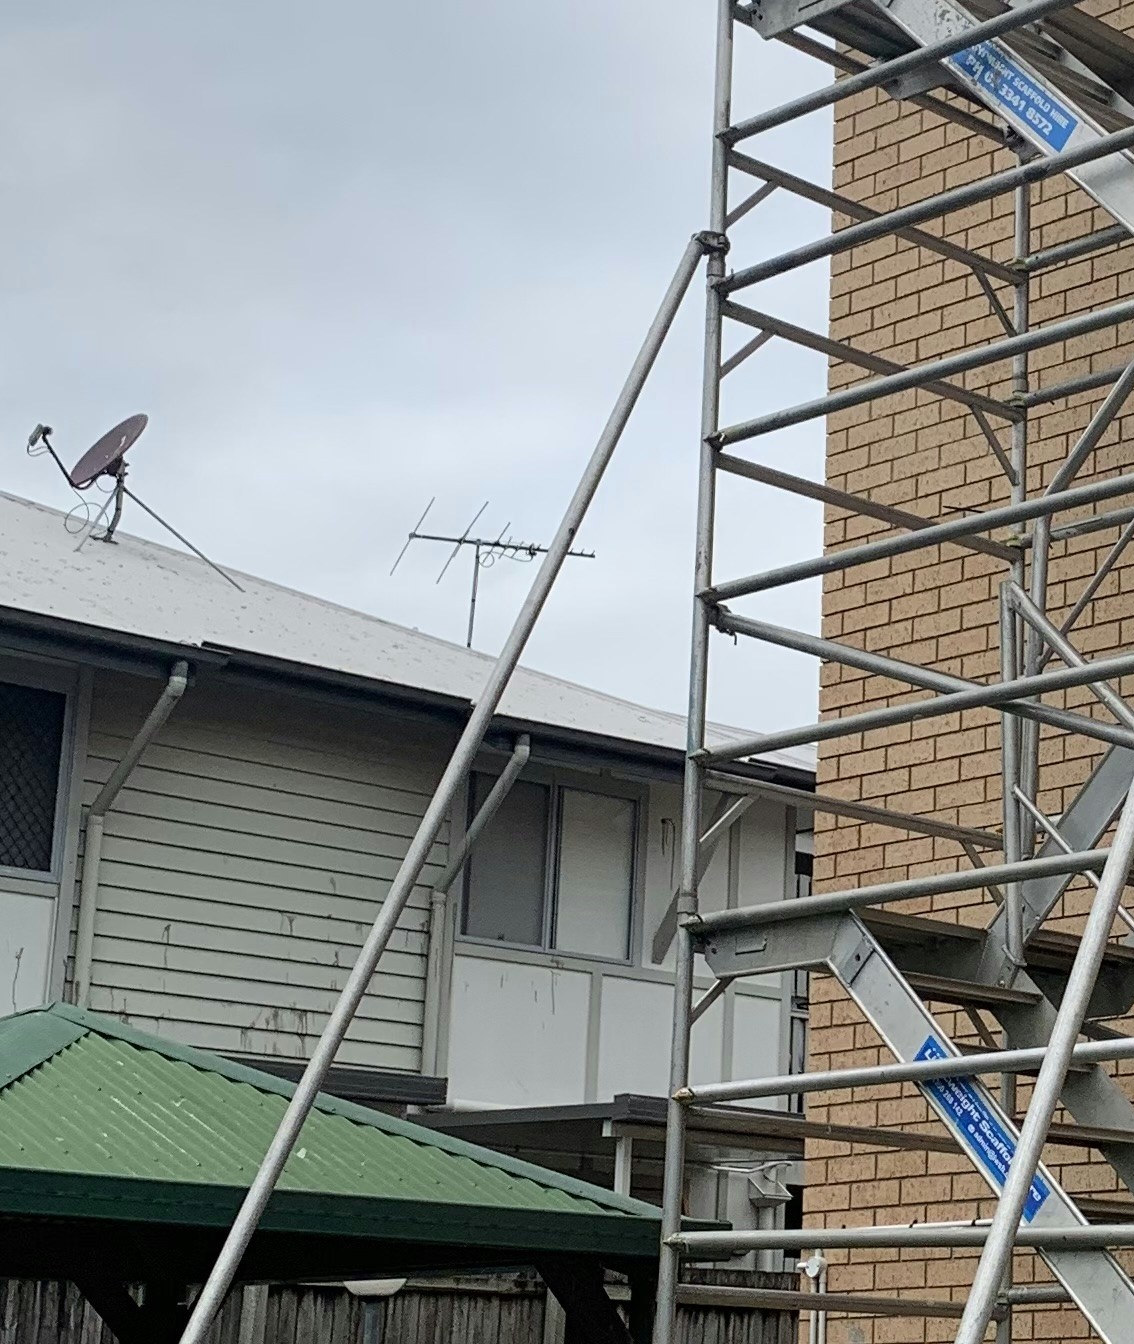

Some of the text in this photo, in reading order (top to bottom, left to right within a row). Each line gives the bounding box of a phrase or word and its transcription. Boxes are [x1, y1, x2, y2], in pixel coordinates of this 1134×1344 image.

[998, 84, 1026, 111] 3341
[1024, 107, 1053, 134] 8572
[1012, 77, 1051, 112] SCAFFOLD
[1049, 108, 1069, 128] HIRE
[979, 1120, 1014, 1164] Scaffo
